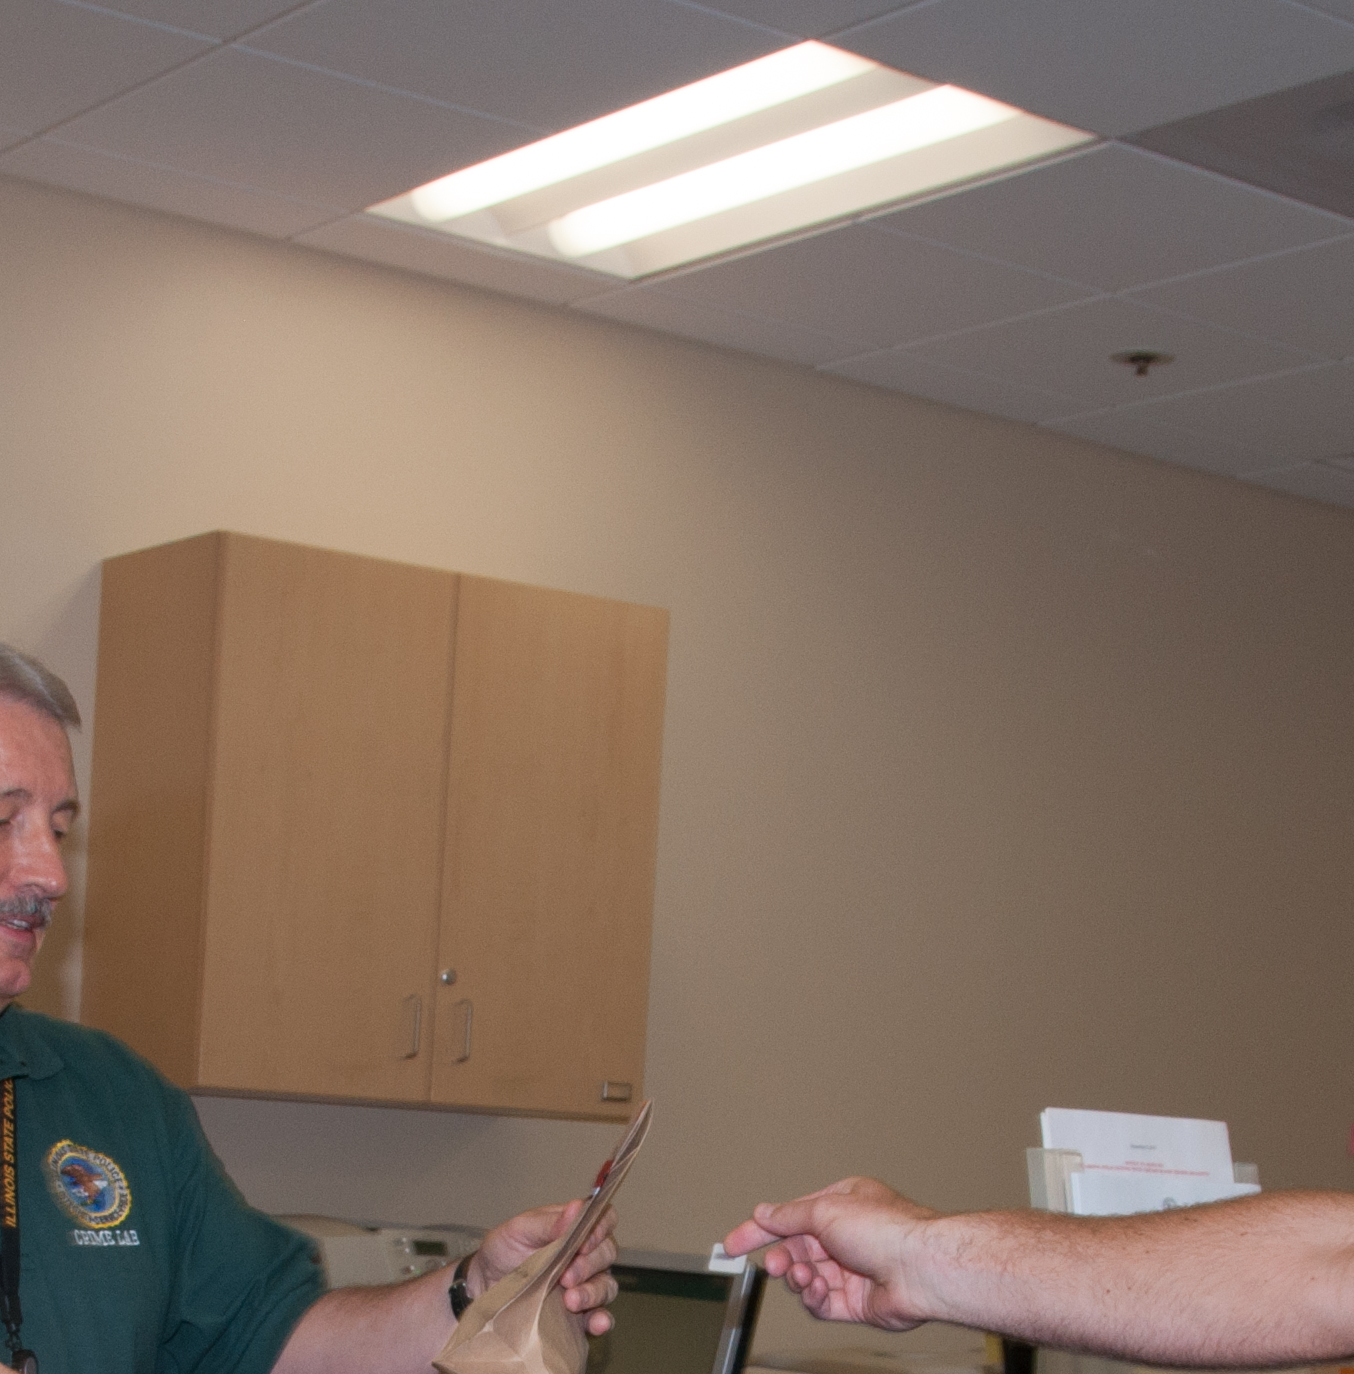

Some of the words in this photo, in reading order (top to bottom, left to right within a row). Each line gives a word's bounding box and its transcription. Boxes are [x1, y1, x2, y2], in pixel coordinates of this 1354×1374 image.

[2, 1118, 15, 1163] STATE
[2, 1170, 17, 1228] ILLINOIS
[74, 1229, 115, 1246] CRIME
[116, 1229, 140, 1246] LAB
